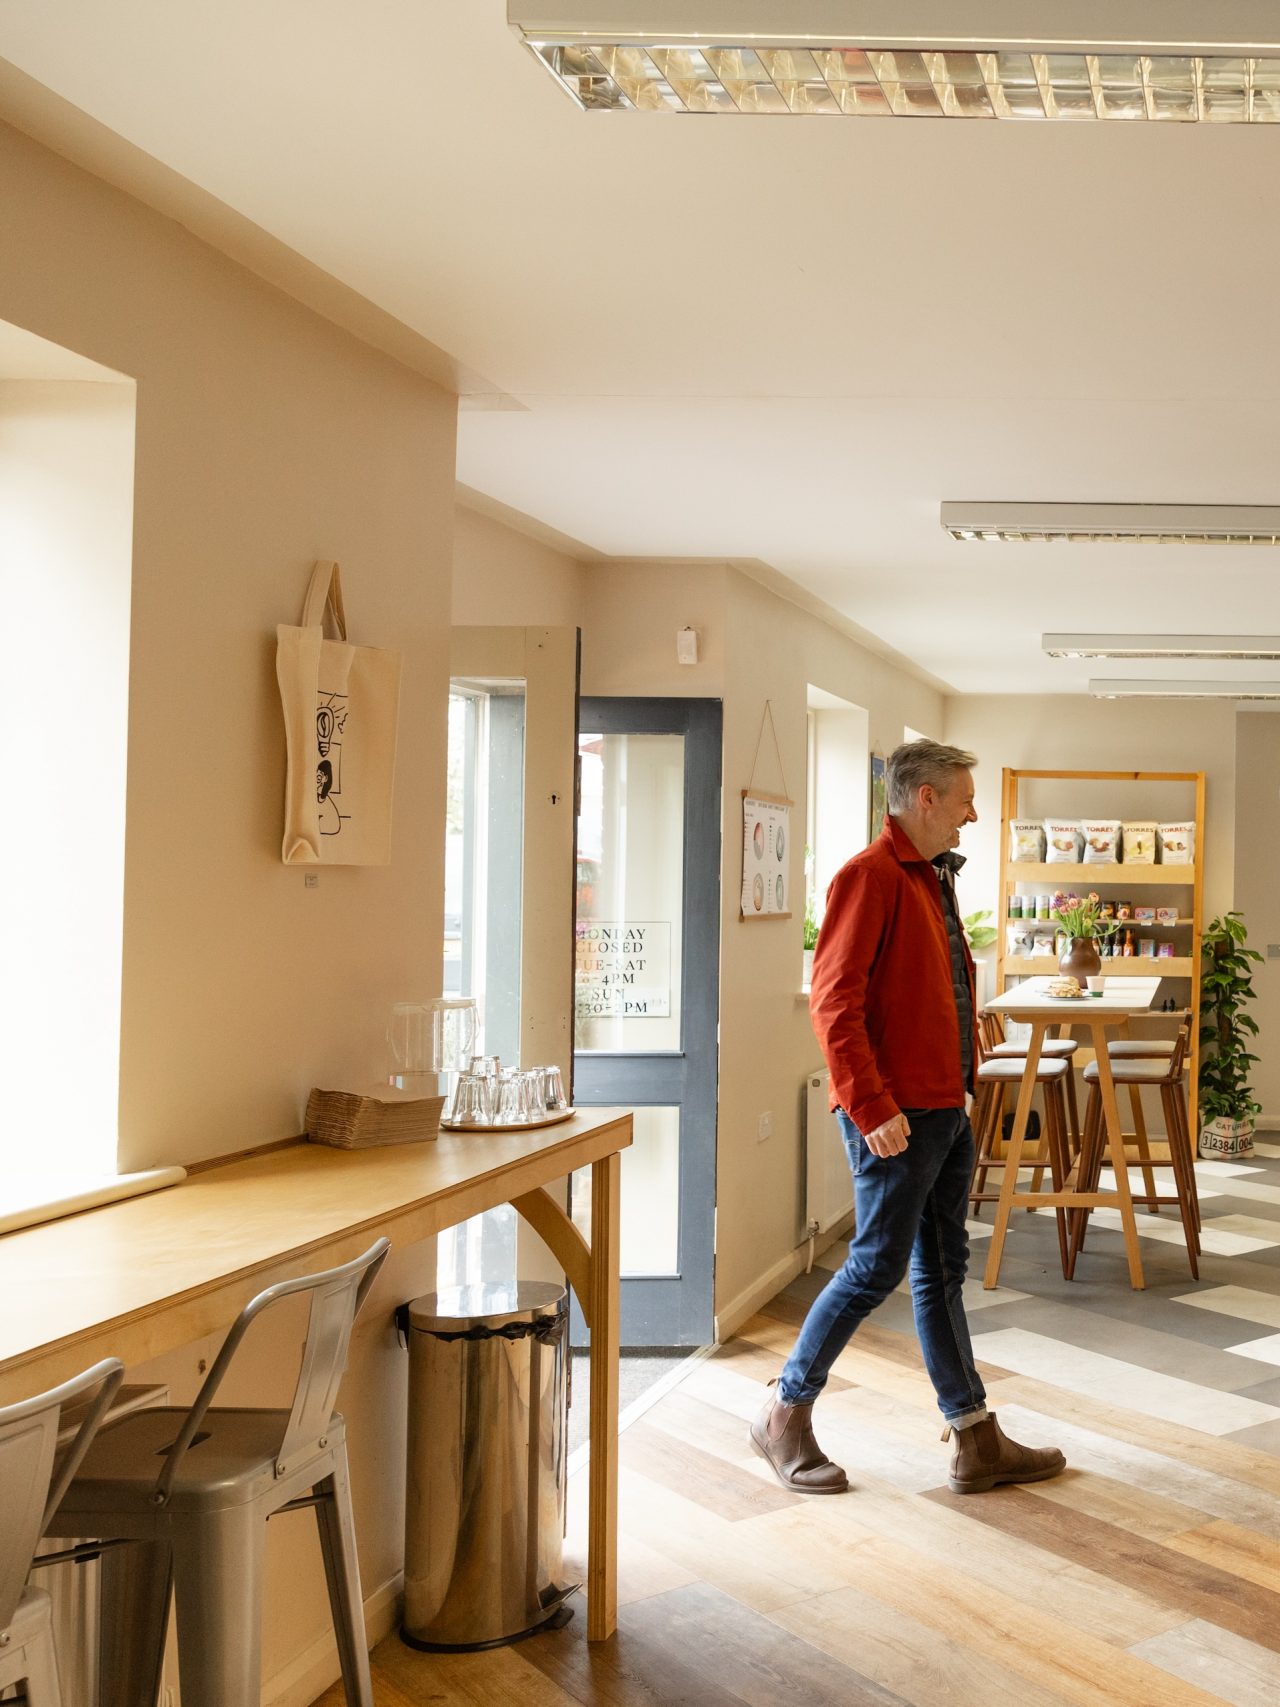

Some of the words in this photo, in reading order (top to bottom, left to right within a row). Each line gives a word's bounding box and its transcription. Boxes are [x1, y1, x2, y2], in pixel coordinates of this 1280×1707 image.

[576, 929, 646, 940] MONDAY
[576, 942, 643, 953] CLOSED
[592, 988, 625, 1001] SUN
[1212, 1138, 1235, 1152] 2384
